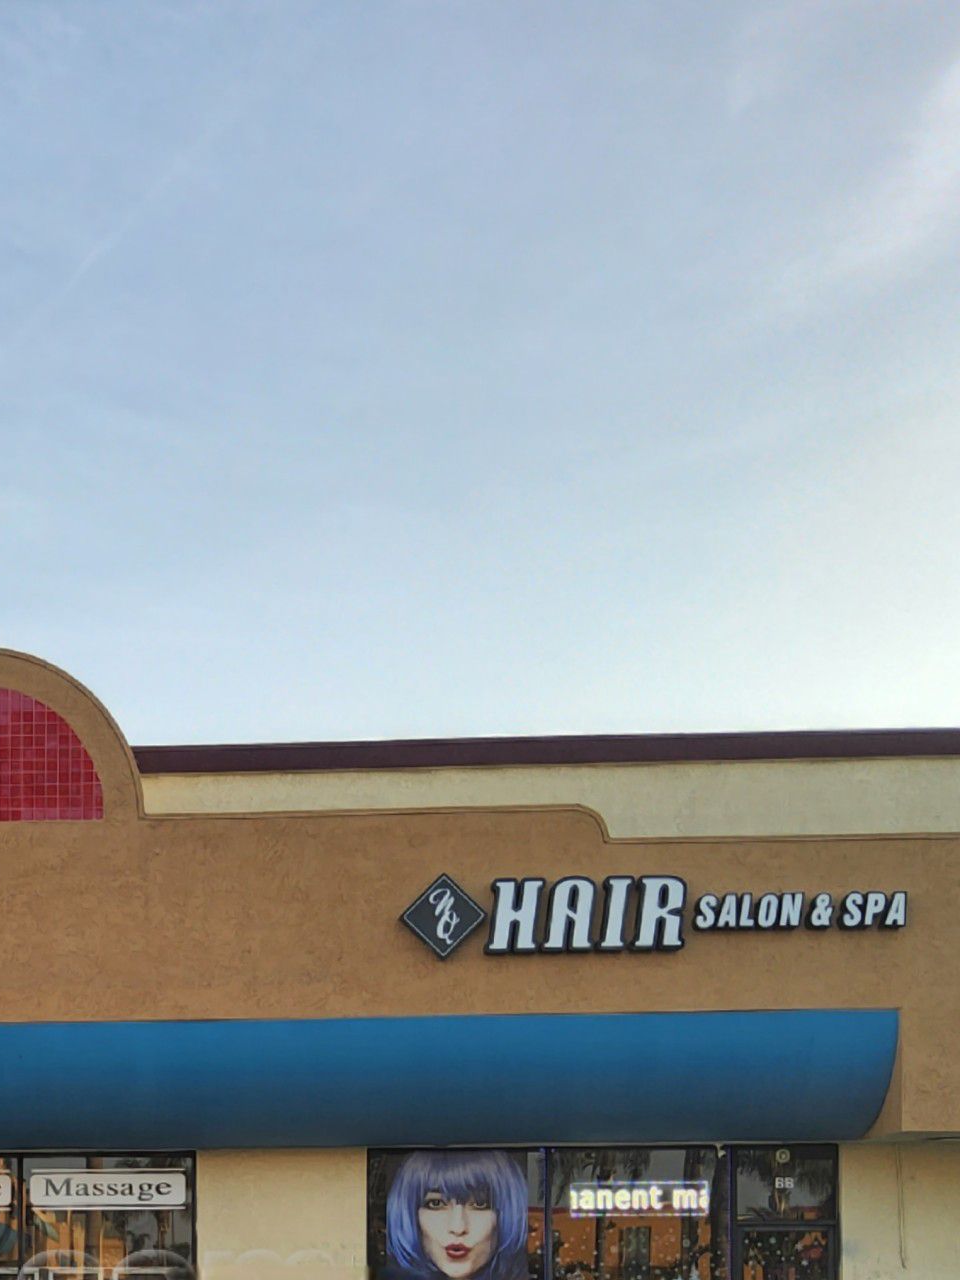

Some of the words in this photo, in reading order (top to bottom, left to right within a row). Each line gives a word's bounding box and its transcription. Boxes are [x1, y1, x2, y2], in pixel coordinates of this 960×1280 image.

[488, 876, 687, 950] HAIR
[695, 892, 803, 928] SALON
[810, 893, 833, 927] &
[842, 891, 907, 927] SPA
[44, 1178, 173, 1202] Massage
